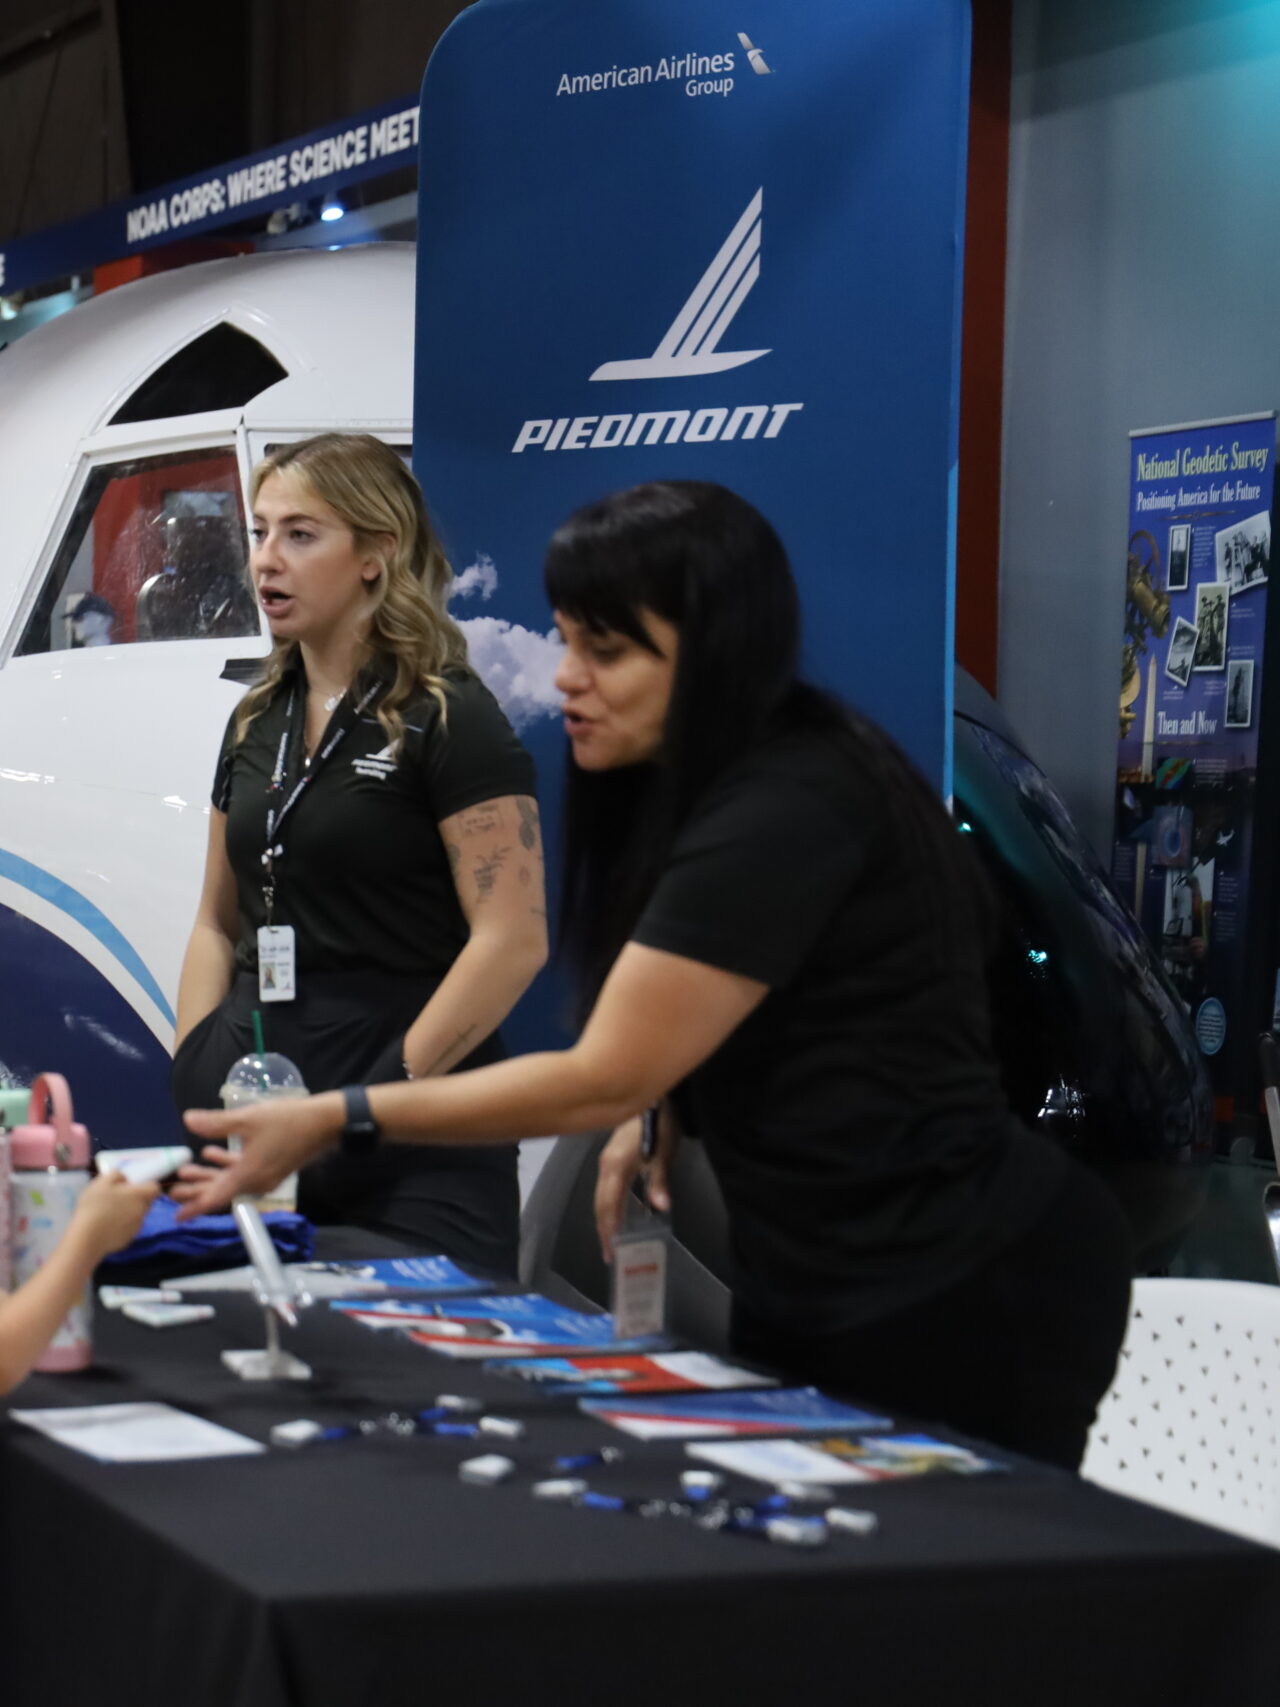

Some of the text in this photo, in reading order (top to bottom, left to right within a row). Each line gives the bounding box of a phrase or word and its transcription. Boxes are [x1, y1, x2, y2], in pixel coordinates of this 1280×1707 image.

[556, 52, 735, 96] American Airlines
[685, 78, 734, 97] Group
[127, 199, 169, 243] NOAA
[170, 178, 226, 228] CORPS:
[227, 154, 287, 208] WHERE
[289, 126, 368, 187] SCIENCE
[512, 403, 804, 453] PIEDMONT
[1136, 442, 1269, 482] National Geodetic Survey
[1136, 480, 1260, 512] Positioning America for the Future
[1158, 710, 1218, 735] Then and Now
